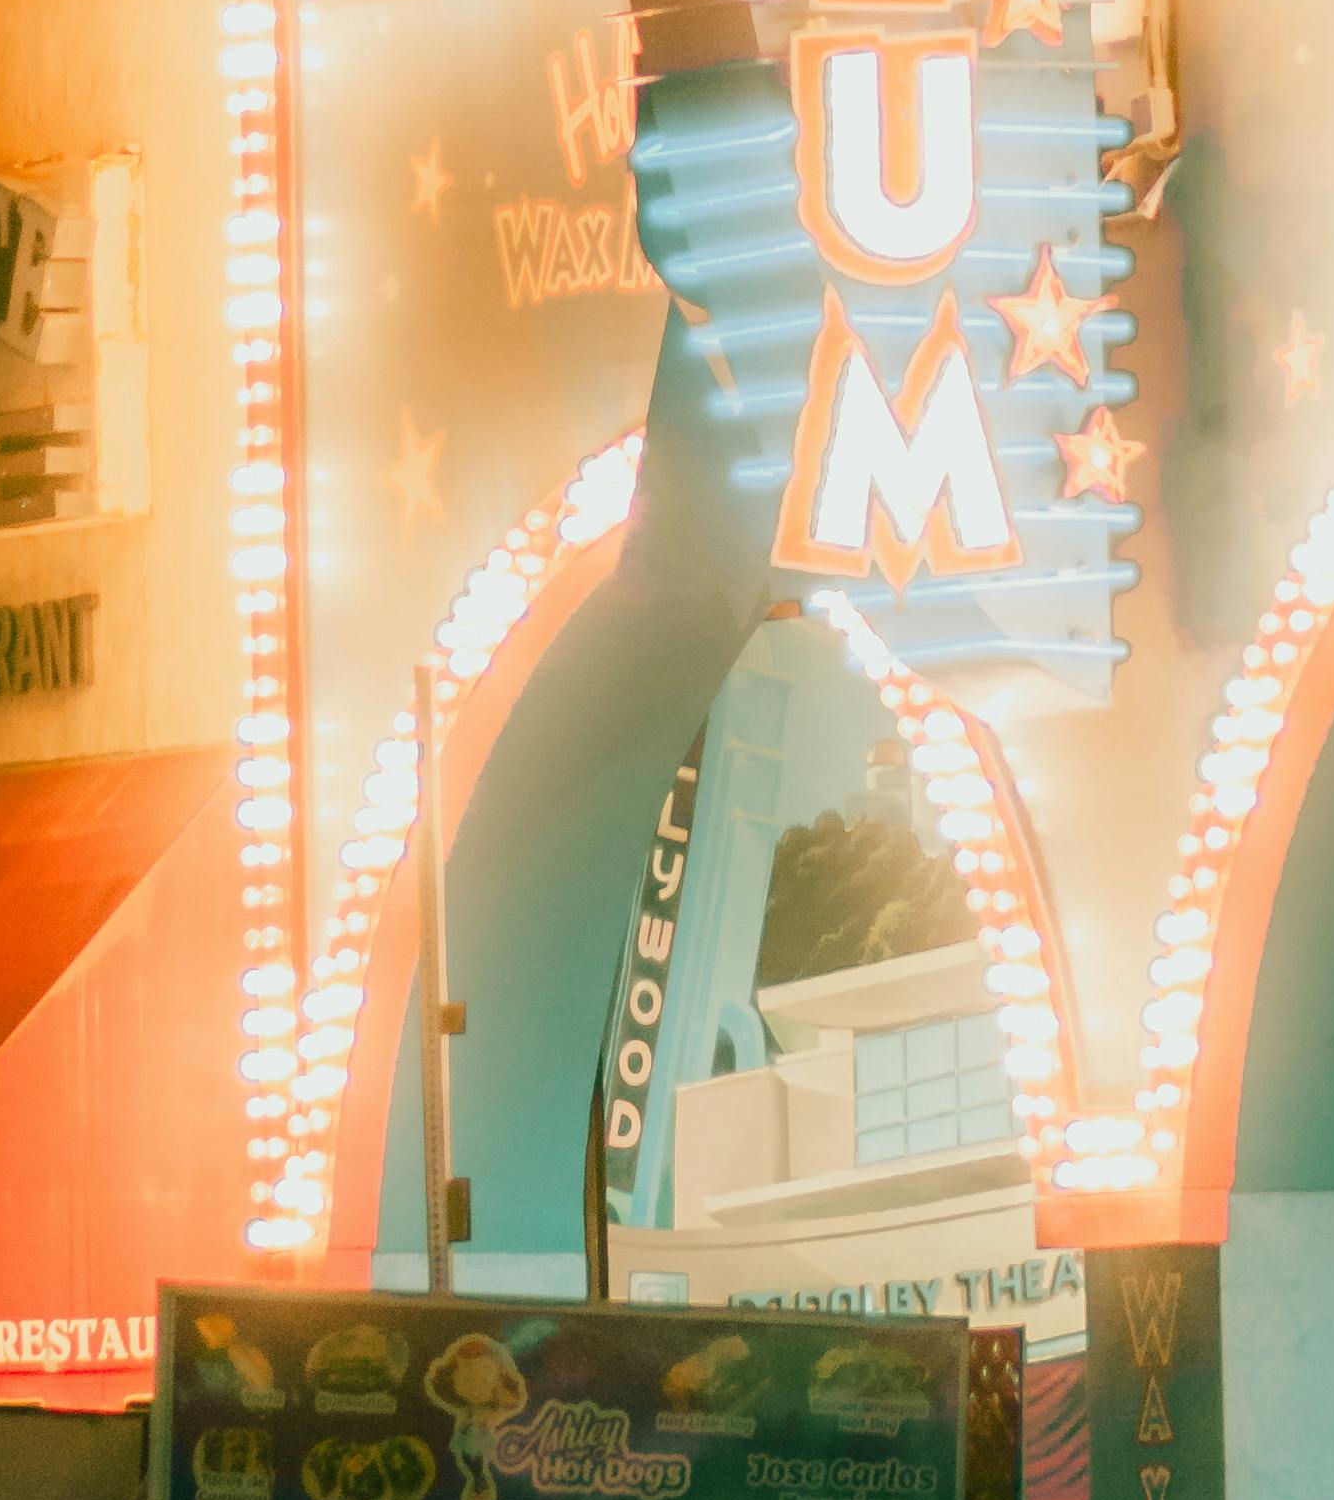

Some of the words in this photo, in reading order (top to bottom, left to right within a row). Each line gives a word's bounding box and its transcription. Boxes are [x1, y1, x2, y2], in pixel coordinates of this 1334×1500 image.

[495, 198, 614, 306] WAX
[606, 764, 698, 1151] LYWOOD
[956, 1253, 1084, 1313] THEA
[497, 1401, 629, 1473] Ashley
[539, 1454, 596, 1486] Hot
[601, 1454, 685, 1497] Dogs
